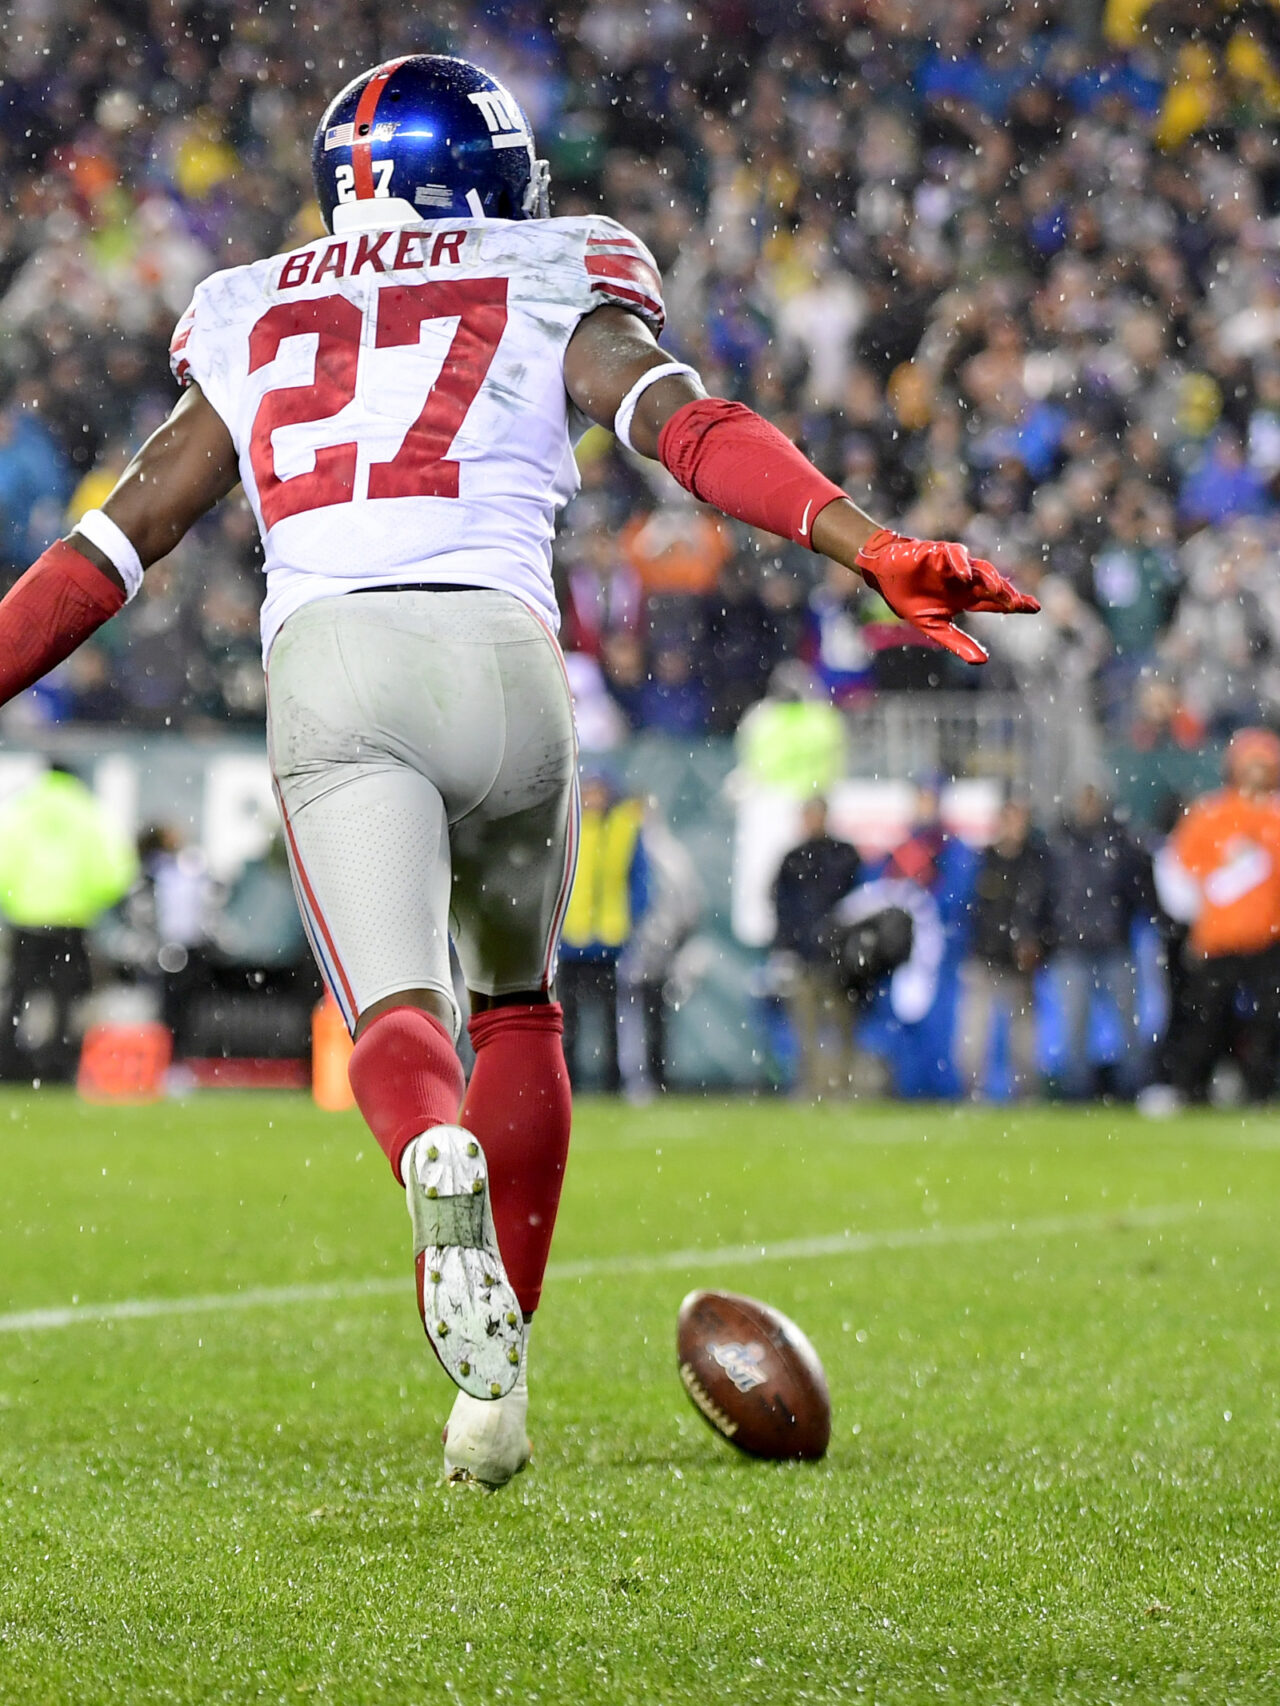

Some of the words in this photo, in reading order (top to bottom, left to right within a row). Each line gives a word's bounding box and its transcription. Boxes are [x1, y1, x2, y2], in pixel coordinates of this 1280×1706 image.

[335, 159, 395, 204] 27
[276, 230, 468, 290] BAKER
[246, 277, 510, 533] 27
